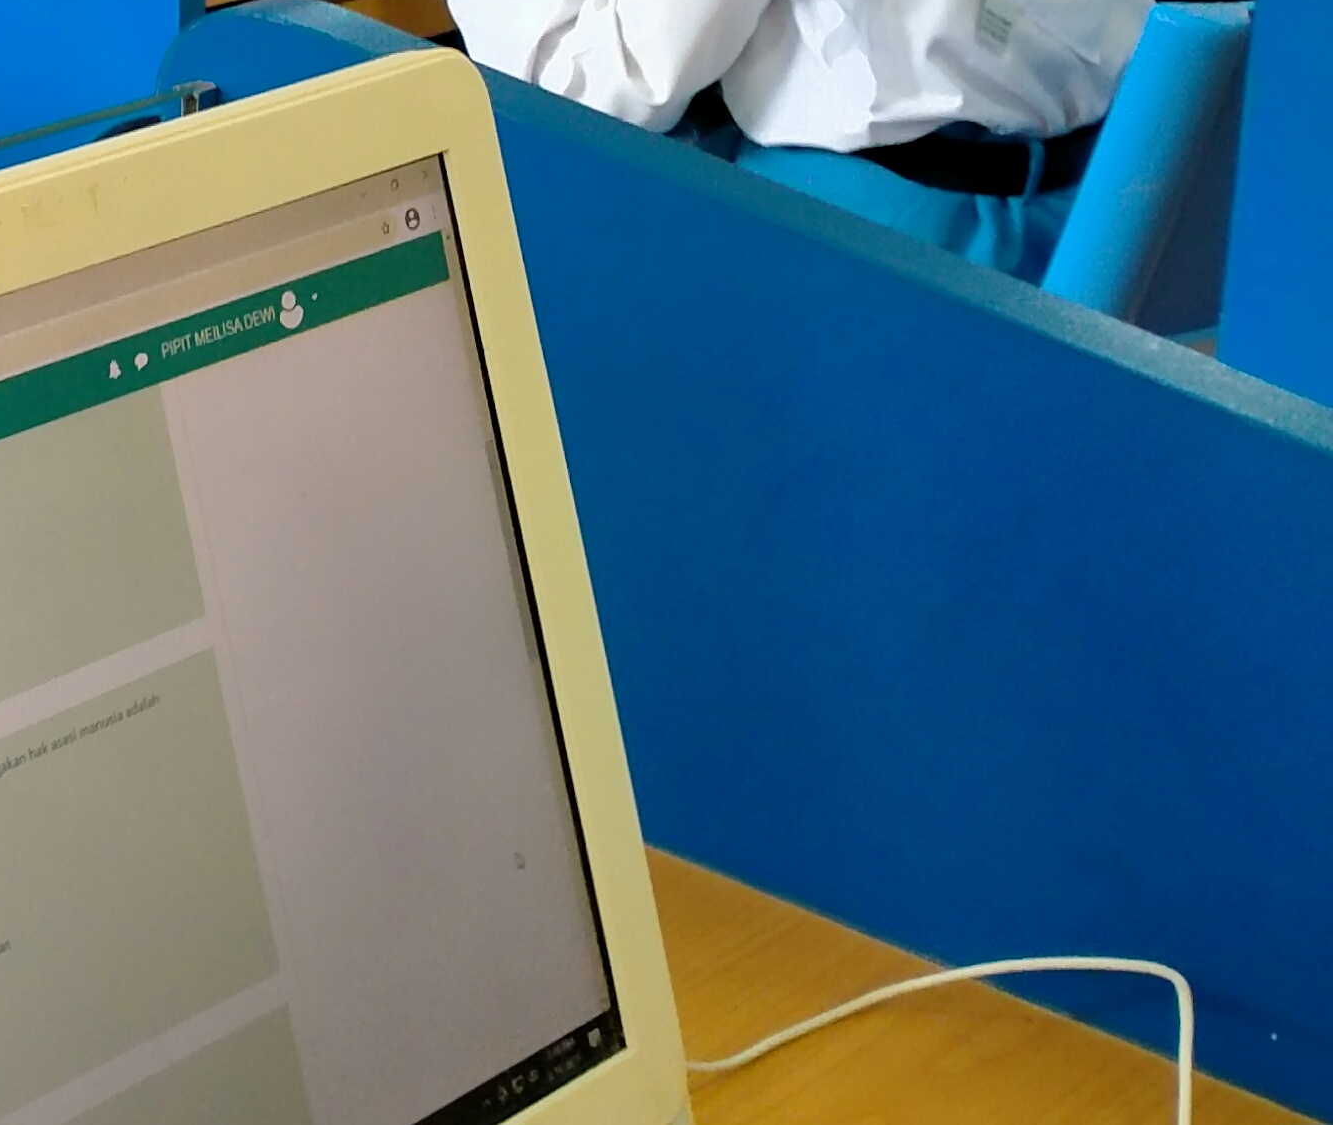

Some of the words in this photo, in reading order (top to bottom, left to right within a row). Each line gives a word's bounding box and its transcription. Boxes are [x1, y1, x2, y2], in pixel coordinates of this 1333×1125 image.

[160, 333, 192, 359] PIPIT
[194, 317, 244, 347] MEILISA
[243, 305, 276, 330] DEWI
[27, 740, 49, 761] hak
[51, 728, 77, 752] asasi
[79, 710, 124, 739] manusia
[125, 692, 161, 718] adalah
